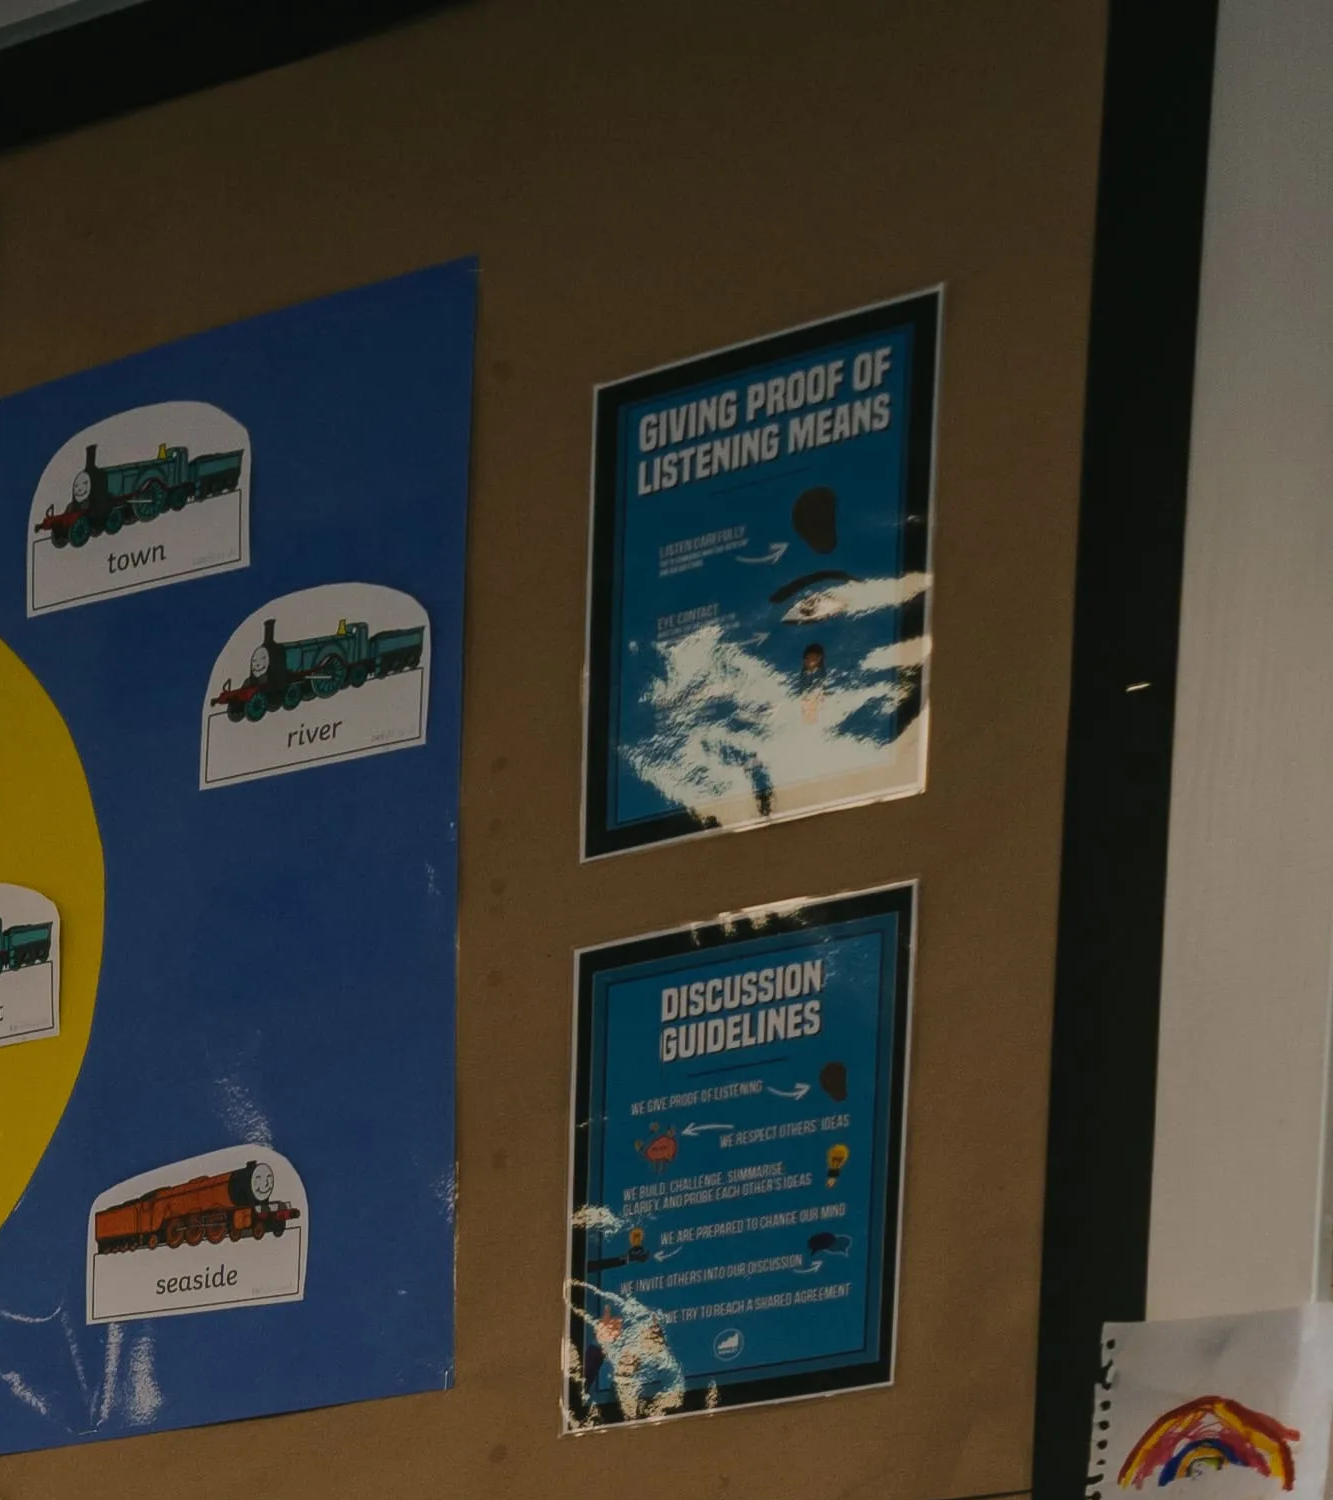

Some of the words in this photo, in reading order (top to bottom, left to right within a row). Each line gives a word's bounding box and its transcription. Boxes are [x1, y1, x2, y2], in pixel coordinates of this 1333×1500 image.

[639, 389, 738, 453] GIVING
[746, 359, 844, 423] PROOF
[852, 346, 893, 392] OF
[637, 423, 781, 496] LISTENING
[787, 392, 891, 454] MEANS
[107, 543, 167, 574] town
[287, 720, 343, 748] river
[661, 958, 824, 1023] DISCUSSION
[661, 1000, 822, 1064] GUIDELINES
[631, 1102, 646, 1116] WE
[647, 1096, 668, 1113] GIVE
[669, 1090, 699, 1109] PROOF
[701, 1088, 713, 1104] OF
[714, 1080, 763, 1102] LISTENING
[720, 1134, 734, 1149] WE
[736, 1126, 777, 1144] RESPECT
[821, 1113, 851, 1131] IDEAS
[623, 1186, 638, 1201] WE
[663, 1195, 683, 1209] AND
[684, 1189, 713, 1207] PROBE
[715, 1185, 740, 1200] EACH
[783, 1172, 813, 1190] IDEAS
[661, 1231, 676, 1245] WE
[676, 1227, 694, 1242] ARE
[695, 1220, 744, 1239] PREPARED
[746, 1216, 759, 1231] TO
[759, 1210, 798, 1229] CHANGE
[799, 1206, 820, 1222] OUR
[820, 1202, 847, 1219] MIND
[155, 1264, 238, 1295] seaside
[620, 1280, 635, 1294] WE
[635, 1275, 665, 1292] INVITE
[666, 1268, 703, 1288] OTHERS
[703, 1266, 725, 1282] INTO
[726, 1262, 746, 1277] OUR
[747, 1254, 804, 1275] DISCUSSION
[664, 1309, 679, 1324] WE
[681, 1306, 699, 1321] TRY
[701, 1304, 713, 1318] TO
[714, 1299, 745, 1316] REACH
[746, 1297, 754, 1311] A
[754, 1292, 793, 1310] SHARED
[794, 1283, 852, 1304] AGREEMENT
